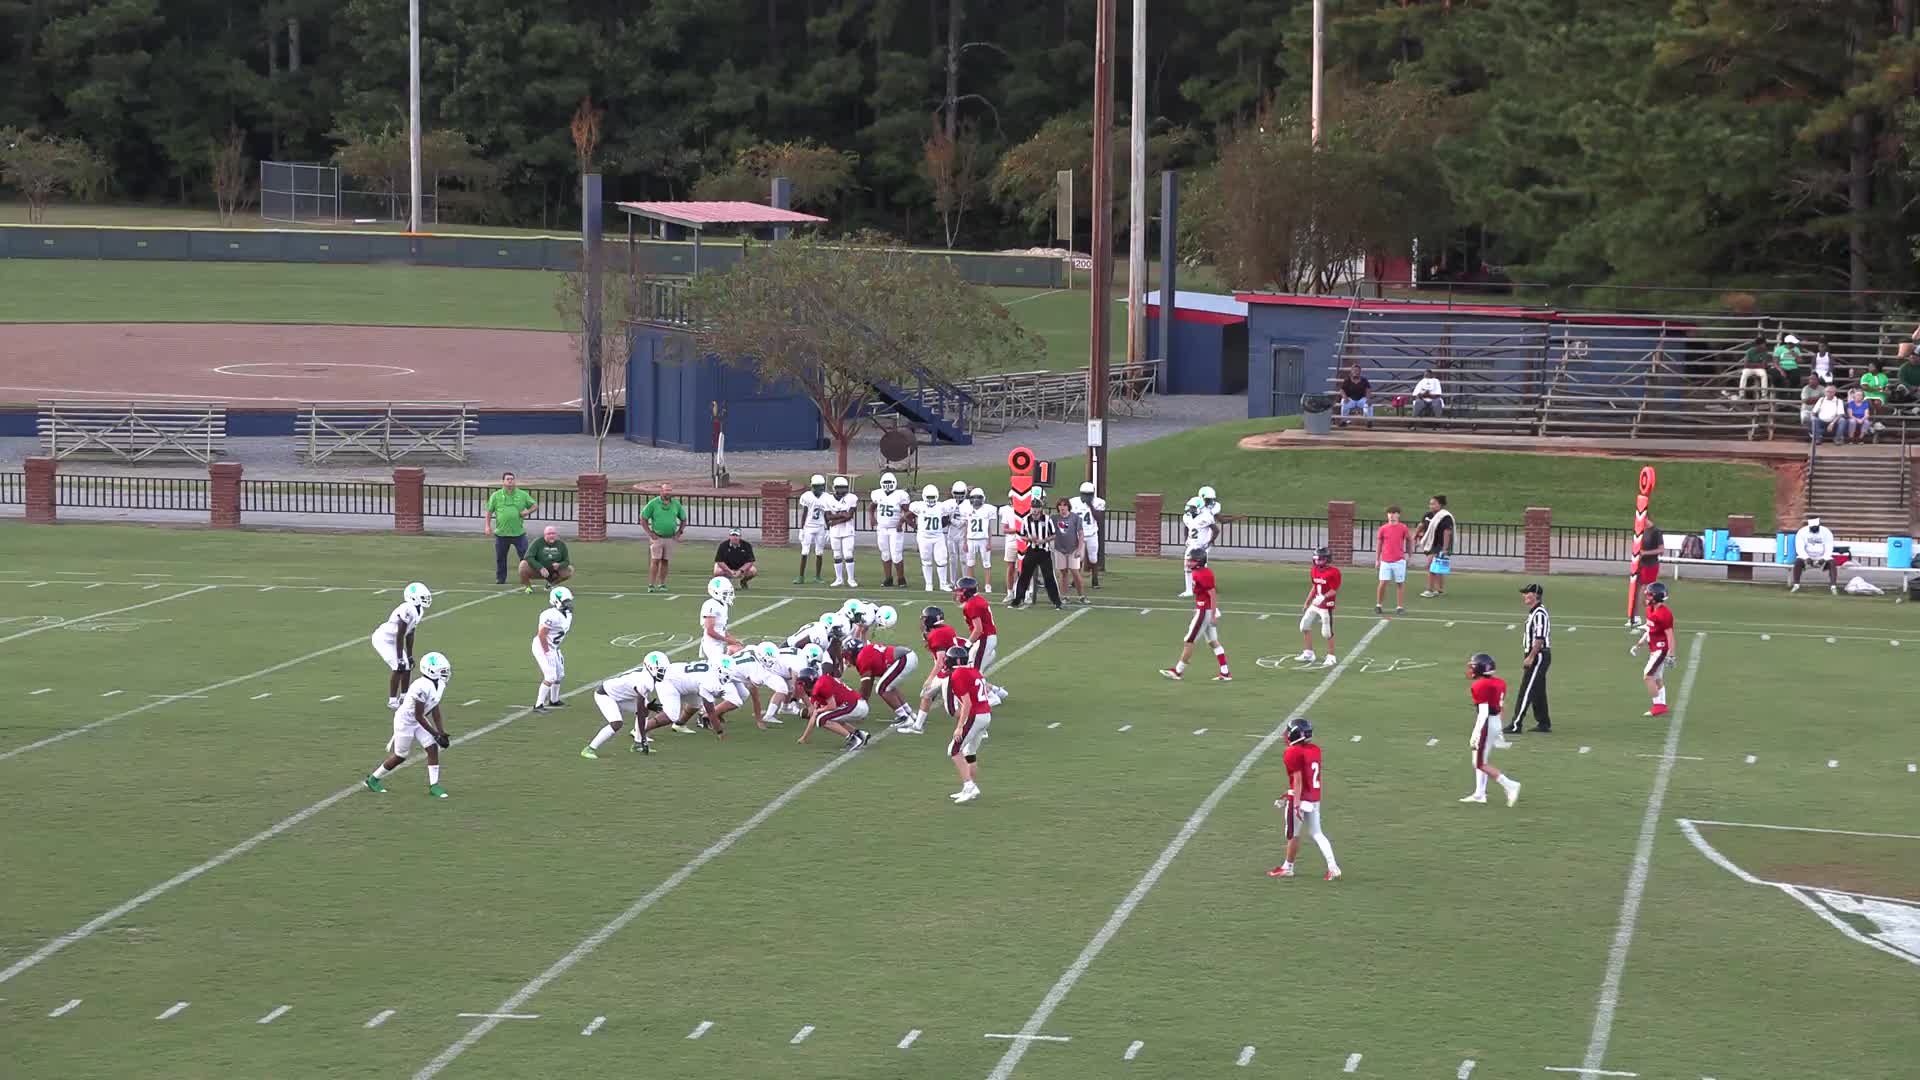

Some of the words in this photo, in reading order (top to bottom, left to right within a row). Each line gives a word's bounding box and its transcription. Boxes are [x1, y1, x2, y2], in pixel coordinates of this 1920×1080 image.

[1040, 462, 1048, 482] 1
[880, 505, 893, 517] 75
[924, 517, 938, 530] 70
[971, 519, 983, 532] 21
[1191, 528, 1198, 539] 2
[1312, 762, 1320, 788] 2
